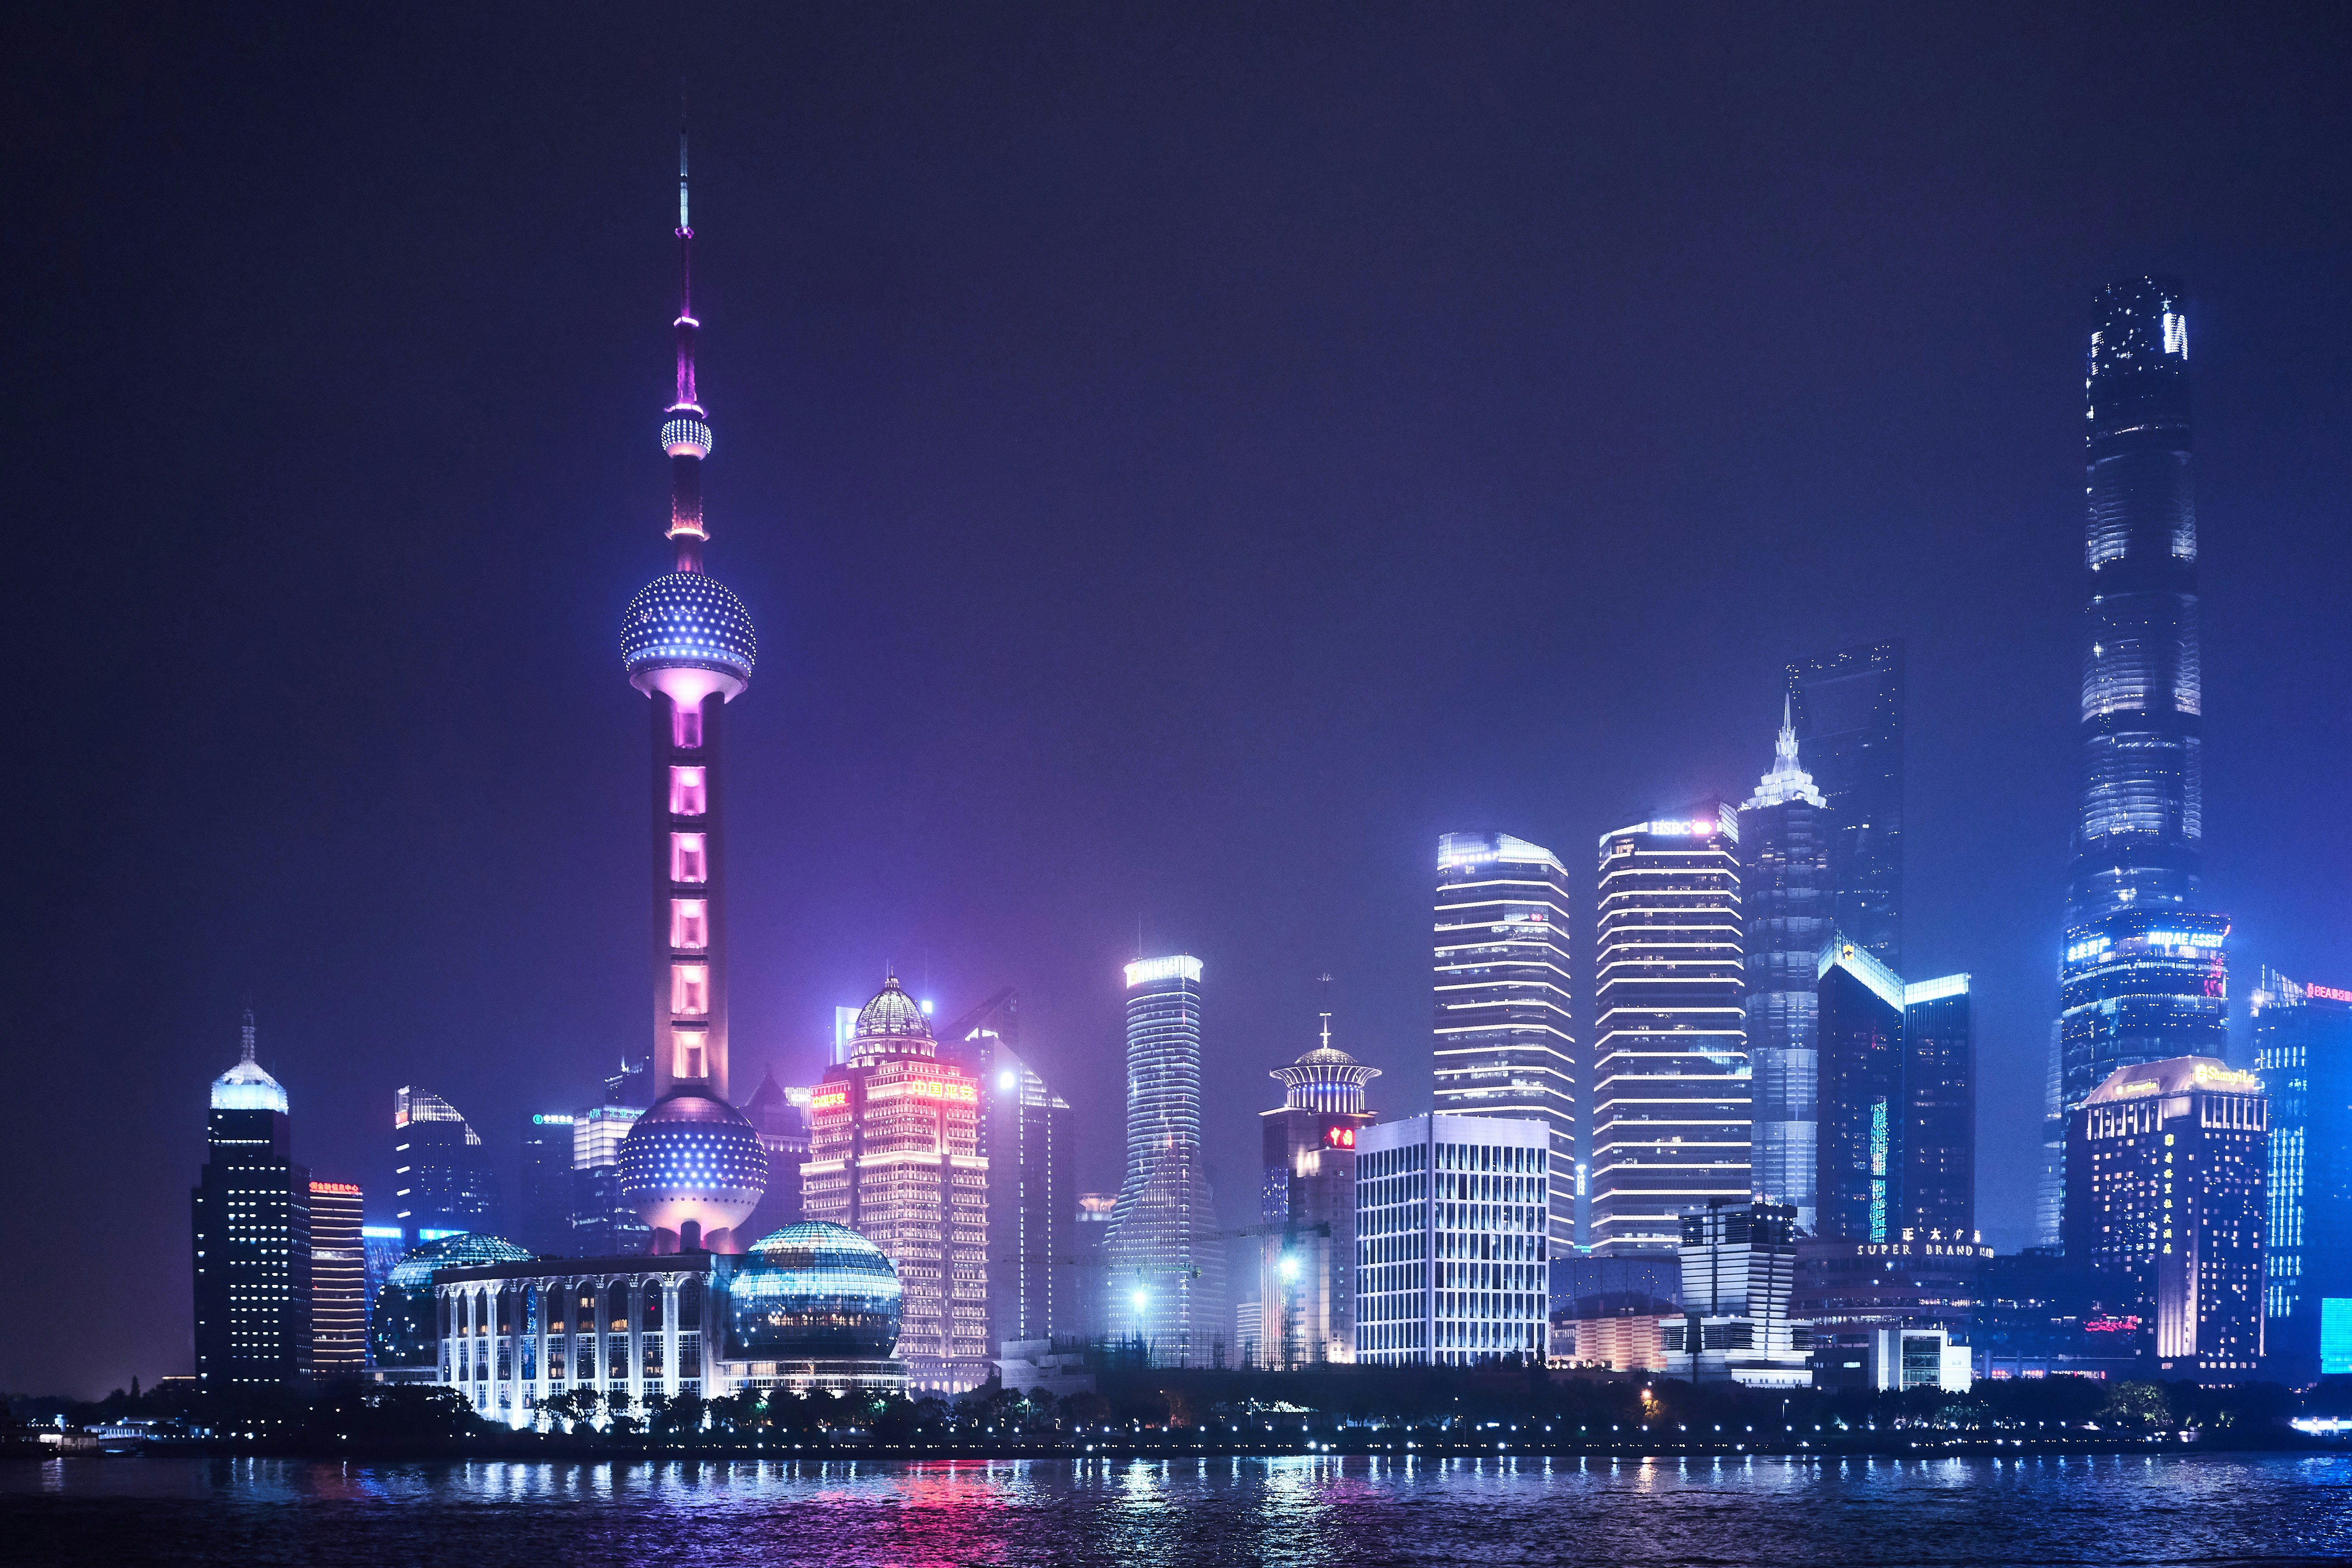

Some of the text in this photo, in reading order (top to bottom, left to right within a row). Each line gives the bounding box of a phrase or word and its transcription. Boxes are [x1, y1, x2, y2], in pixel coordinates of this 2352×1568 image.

[1651, 822, 1691, 835] HSBC
[2148, 932, 2224, 948] MIRAE ASSET
[2067, 937, 2111, 962] 未来资产
[2315, 986, 2332, 999] BEA
[912, 1080, 974, 1101] 中国平安
[812, 1092, 845, 1107] 中国平安
[309, 1181, 359, 1191] 国金融信息中心
[2163, 1152, 2173, 1254] 香格里拉大酒店
[1857, 1244, 1912, 1255] SUPER
[1925, 1244, 1973, 1256] BRAND
